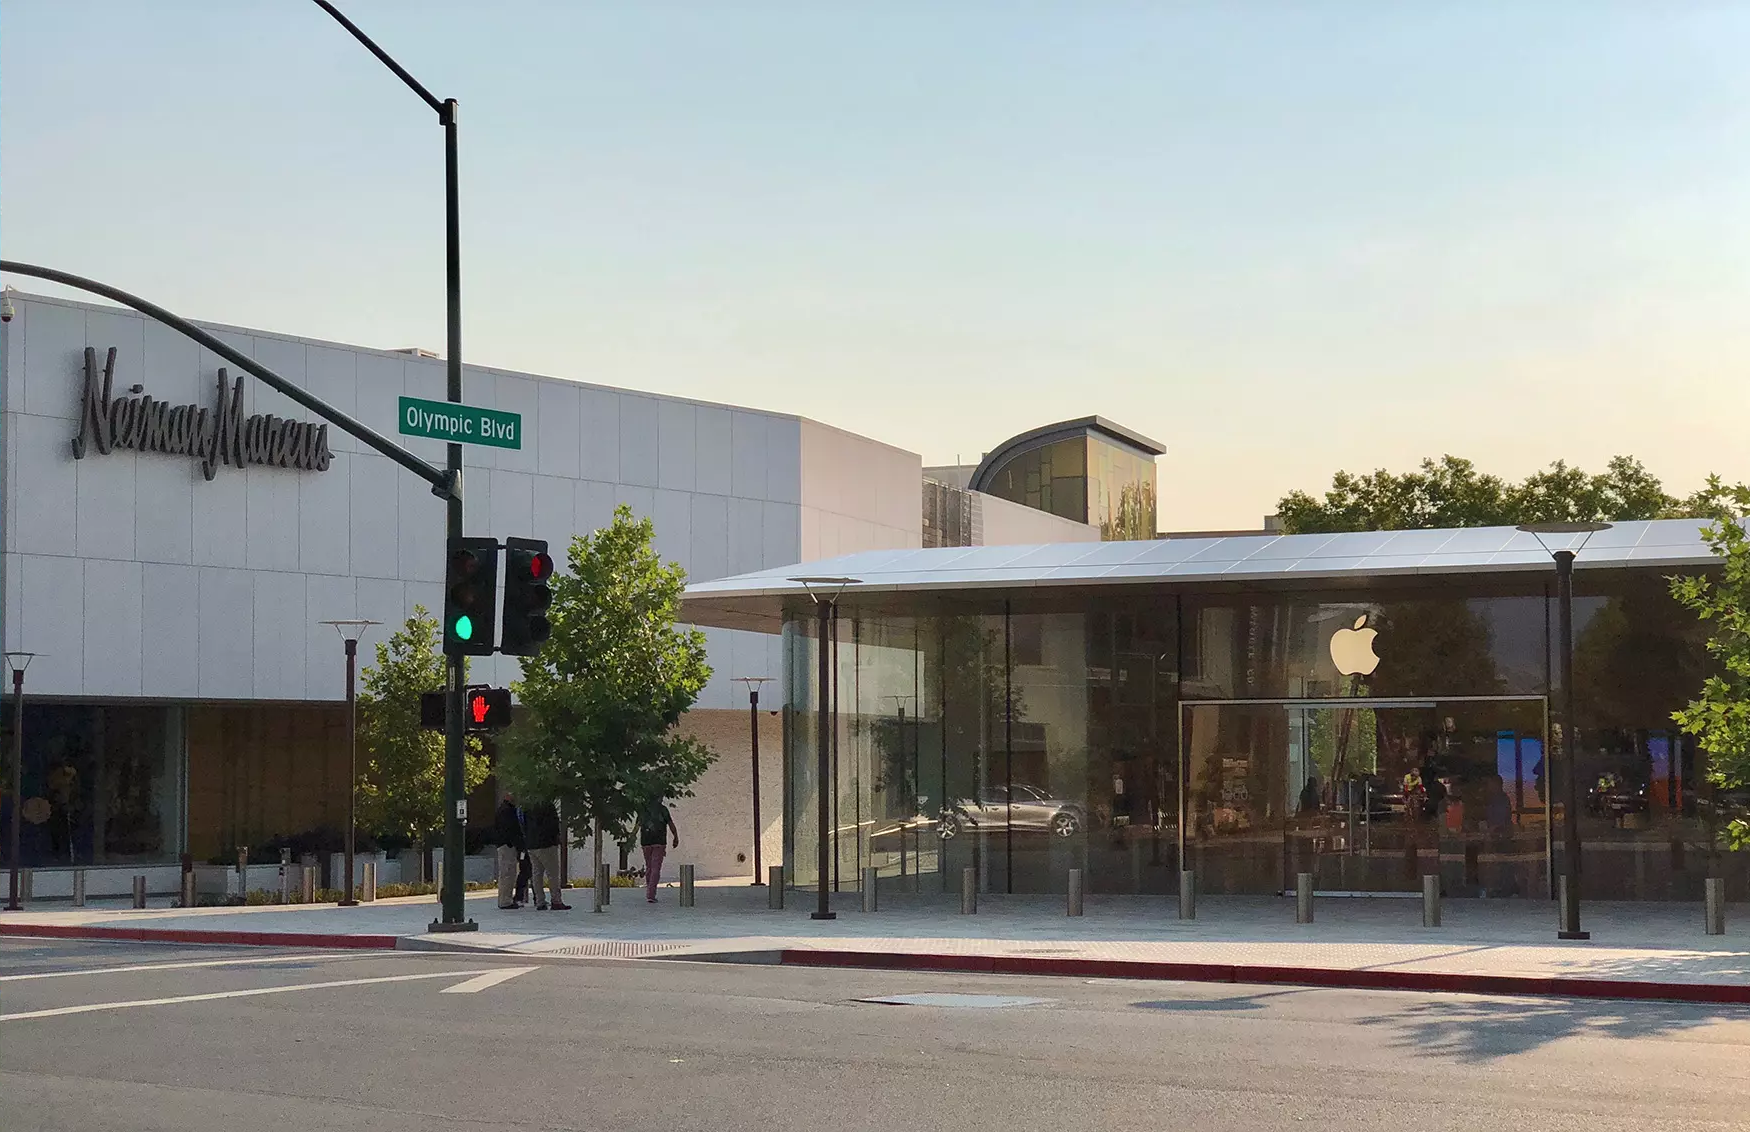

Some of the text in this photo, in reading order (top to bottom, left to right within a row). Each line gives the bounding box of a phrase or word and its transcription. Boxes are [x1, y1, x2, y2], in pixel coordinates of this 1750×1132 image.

[71, 346, 335, 481] Neiman Marcus
[406, 406, 515, 441] Olympic Blvd
